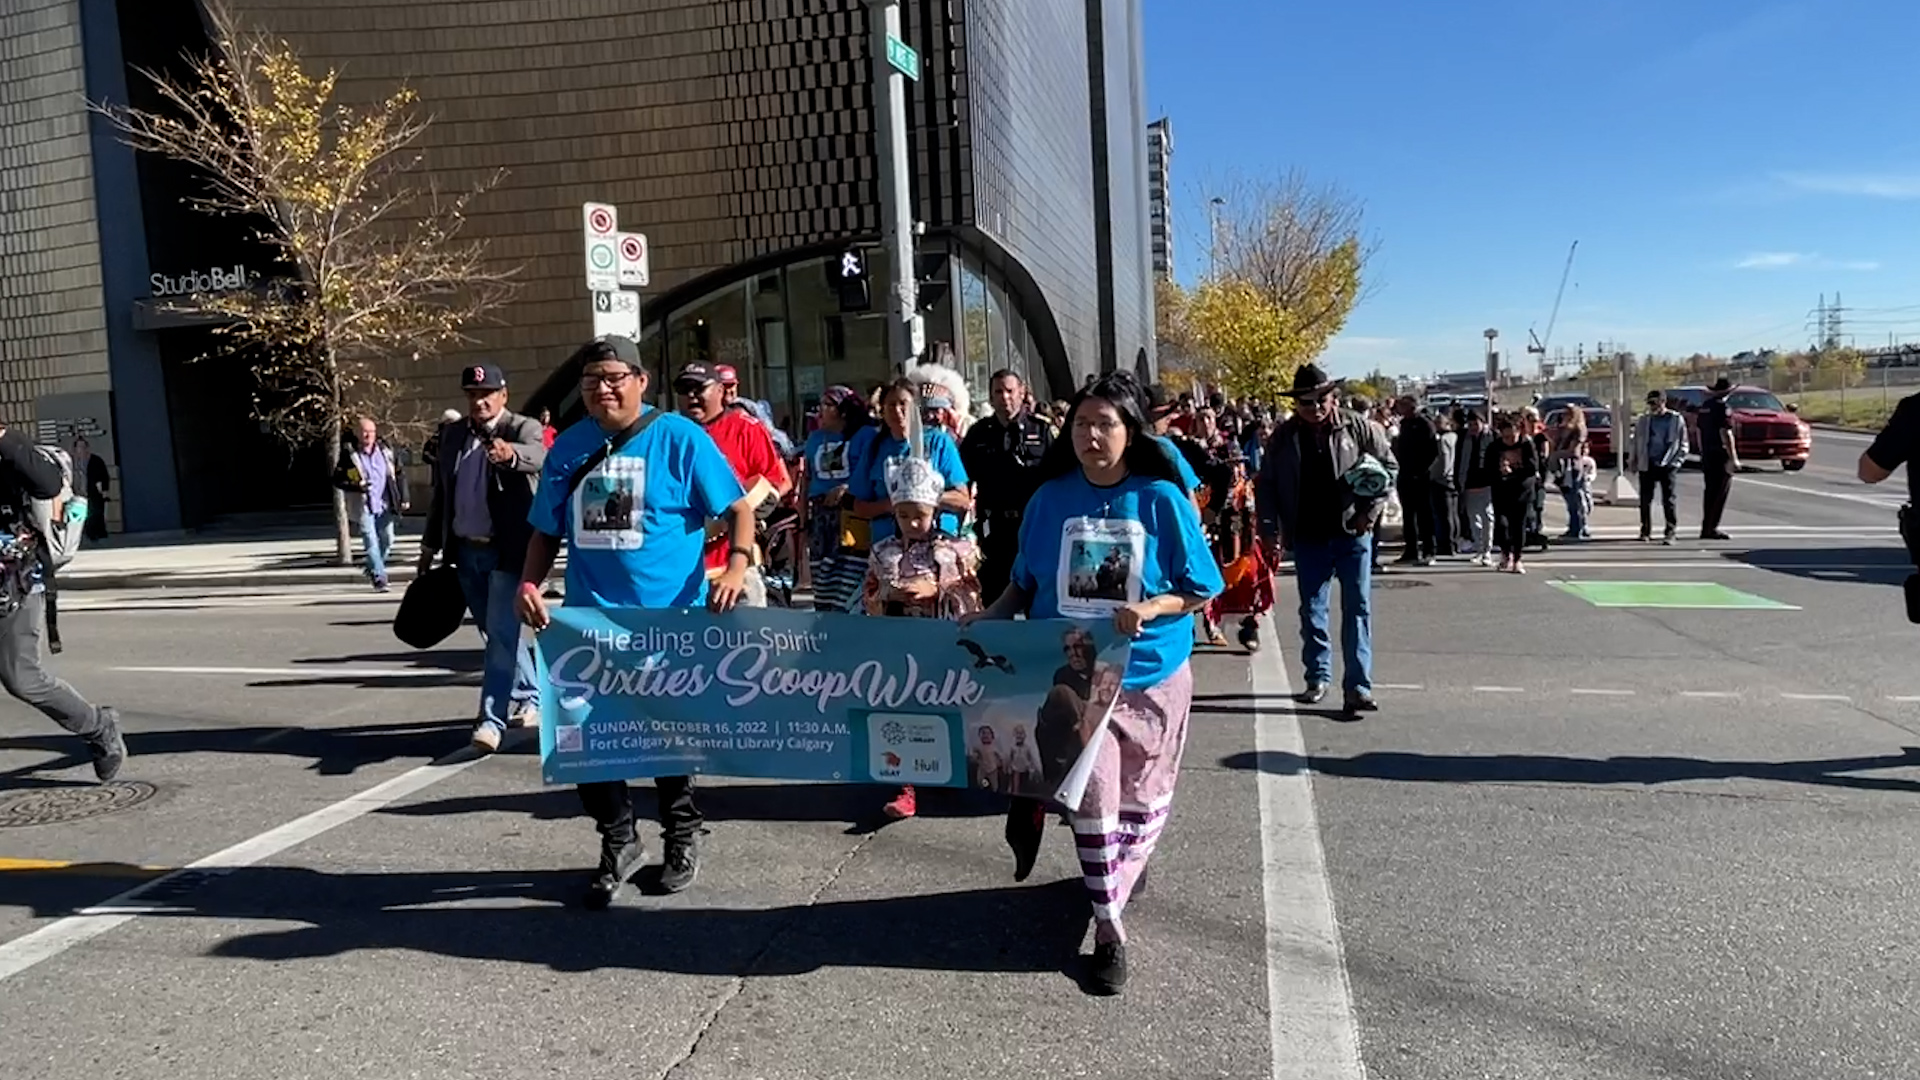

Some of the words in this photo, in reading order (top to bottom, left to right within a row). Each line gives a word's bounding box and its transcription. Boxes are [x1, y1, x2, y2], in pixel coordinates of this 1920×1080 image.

[473, 366, 485, 382] B
[582, 626, 693, 655] "Healing
[703, 626, 752, 648] Our
[759, 627, 828, 656] Spirit"
[550, 646, 713, 711] Sixties
[716, 643, 852, 714] Scoop
[850, 653, 985, 708] Walk
[589, 720, 648, 736] SUNDAY,
[651, 720, 711, 734] OCTOBER
[715, 722, 733, 736] 16,
[736, 721, 768, 734] 2022
[787, 721, 819, 734] 11:30
[821, 723, 851, 735] A.M.
[589, 738, 618, 750] Fort
[621, 736, 673, 750] Calgary
[675, 736, 685, 746] &
[687, 736, 734, 750] Central
[736, 737, 784, 751] Library
[786, 736, 834, 752] Calgary
